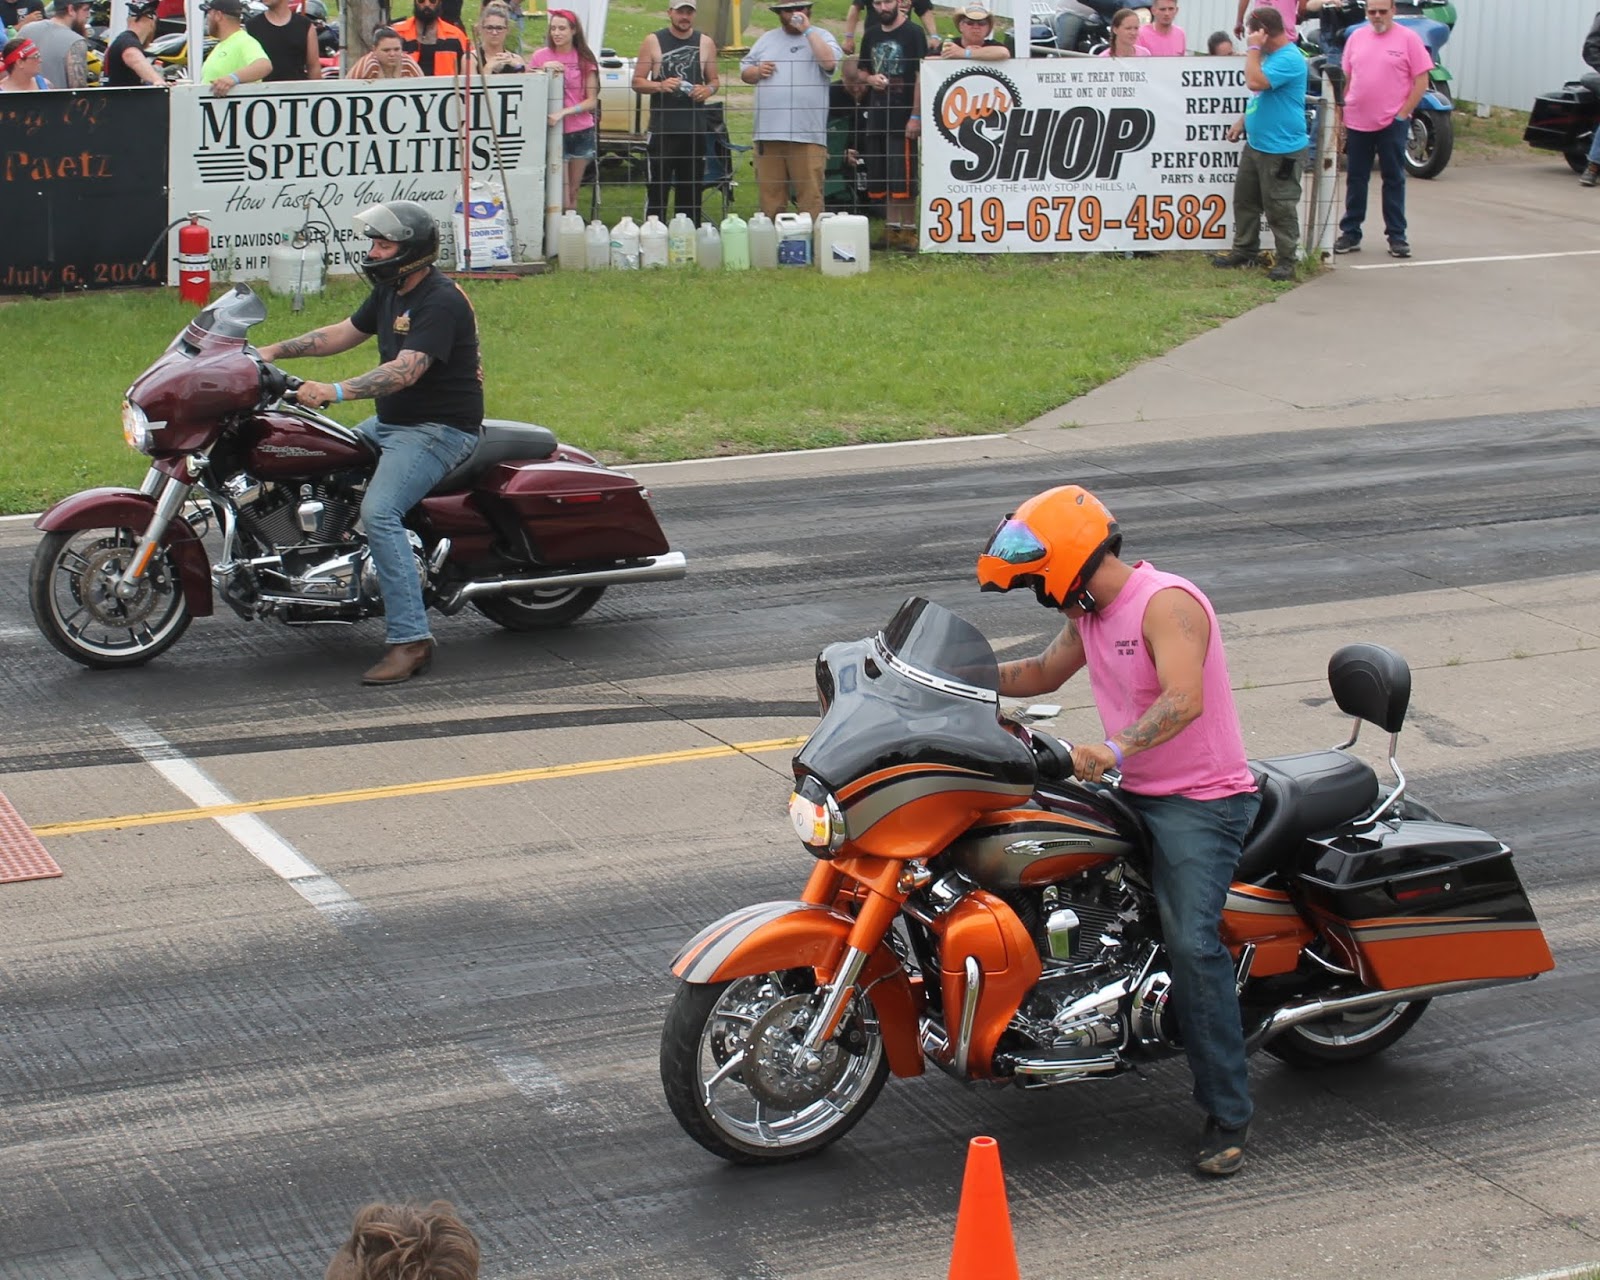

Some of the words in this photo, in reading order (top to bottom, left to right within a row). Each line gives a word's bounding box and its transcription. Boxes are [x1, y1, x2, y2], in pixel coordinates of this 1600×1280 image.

[1036, 72, 1067, 83] WHERE
[1070, 72, 1084, 83] WE
[1087, 71, 1115, 83] TREAT
[1118, 71, 1149, 84] YOURS,
[1181, 70, 1246, 87] SERVIC
[1053, 87, 1073, 99] LIKE
[1076, 87, 1093, 98] ONE
[1097, 87, 1108, 98] OF
[1111, 86, 1136, 98] OURS!
[942, 86, 1014, 130] Our
[1185, 97, 1247, 114] REPAI
[199, 90, 523, 151] MOTORCYCLE
[949, 106, 1156, 183] SHOP
[248, 135, 491, 181] SPECIALTIES
[1151, 151, 1239, 168] PERFORM
[1160, 173, 1194, 184] PARTS
[1197, 173, 1205, 183] &
[1209, 173, 1236, 183] ACCE
[225, 185, 265, 212] How
[272, 183, 314, 210] Fast
[317, 183, 344, 209] Do
[353, 178, 384, 207] You
[392, 178, 448, 202] Wanna
[947, 184, 982, 193] SOUTH
[984, 184, 998, 193] OF
[1001, 183, 1019, 193] THE
[1021, 183, 1050, 193] 4-WAY
[1054, 183, 1080, 192] STOP
[1082, 183, 1093, 192] IN
[1095, 182, 1125, 193] HILLS,
[1126, 182, 1137, 191] IA
[928, 193, 1227, 243] 319-679-4582
[234, 232, 284, 248] DAVIDSO
[246, 255, 257, 269] HI
